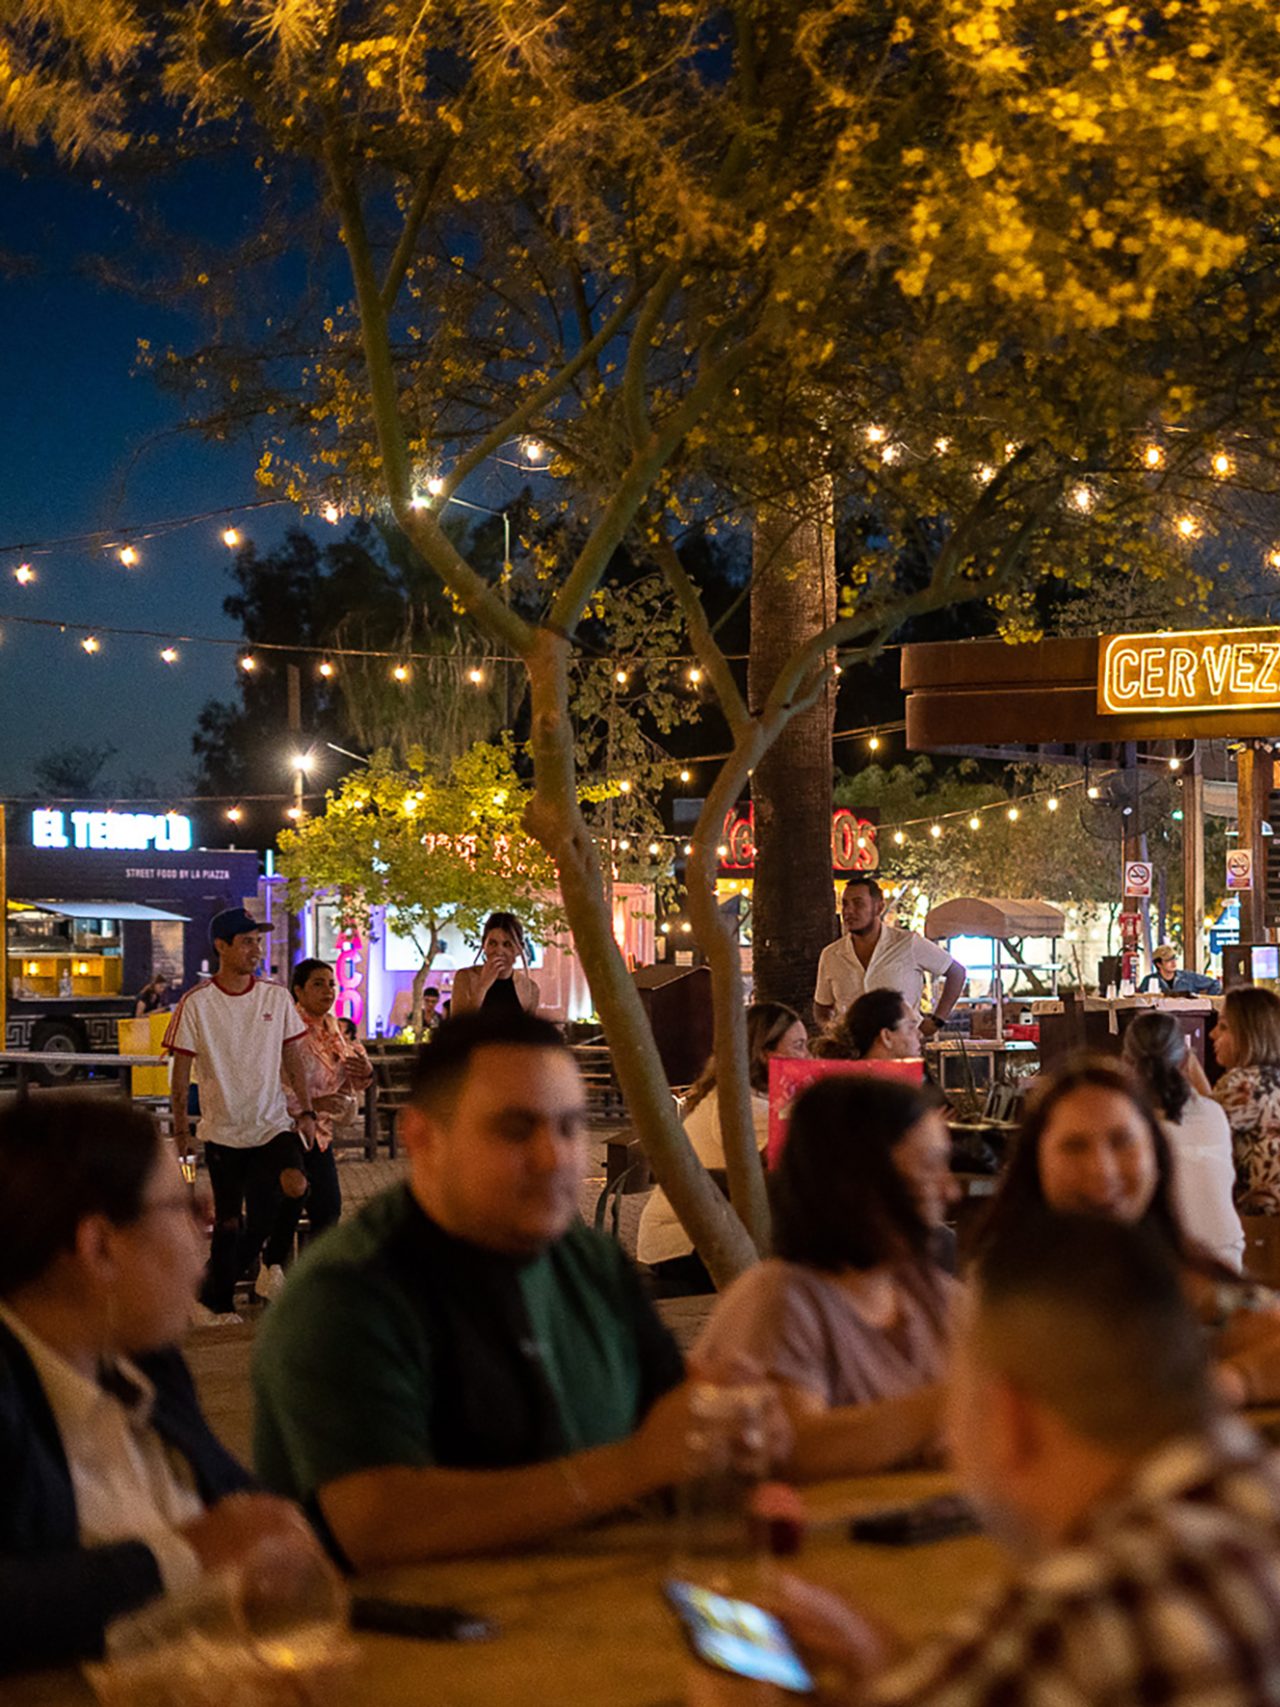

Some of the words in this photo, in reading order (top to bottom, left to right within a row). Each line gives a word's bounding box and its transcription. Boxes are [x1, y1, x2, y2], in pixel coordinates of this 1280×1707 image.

[32, 809, 69, 849] EL
[71, 810, 193, 852] TEMPLO
[125, 868, 155, 879] STREET
[156, 868, 177, 879] FOOD
[179, 869, 189, 879] BY
[190, 869, 200, 879] LA
[202, 869, 230, 880] PIAZZA
